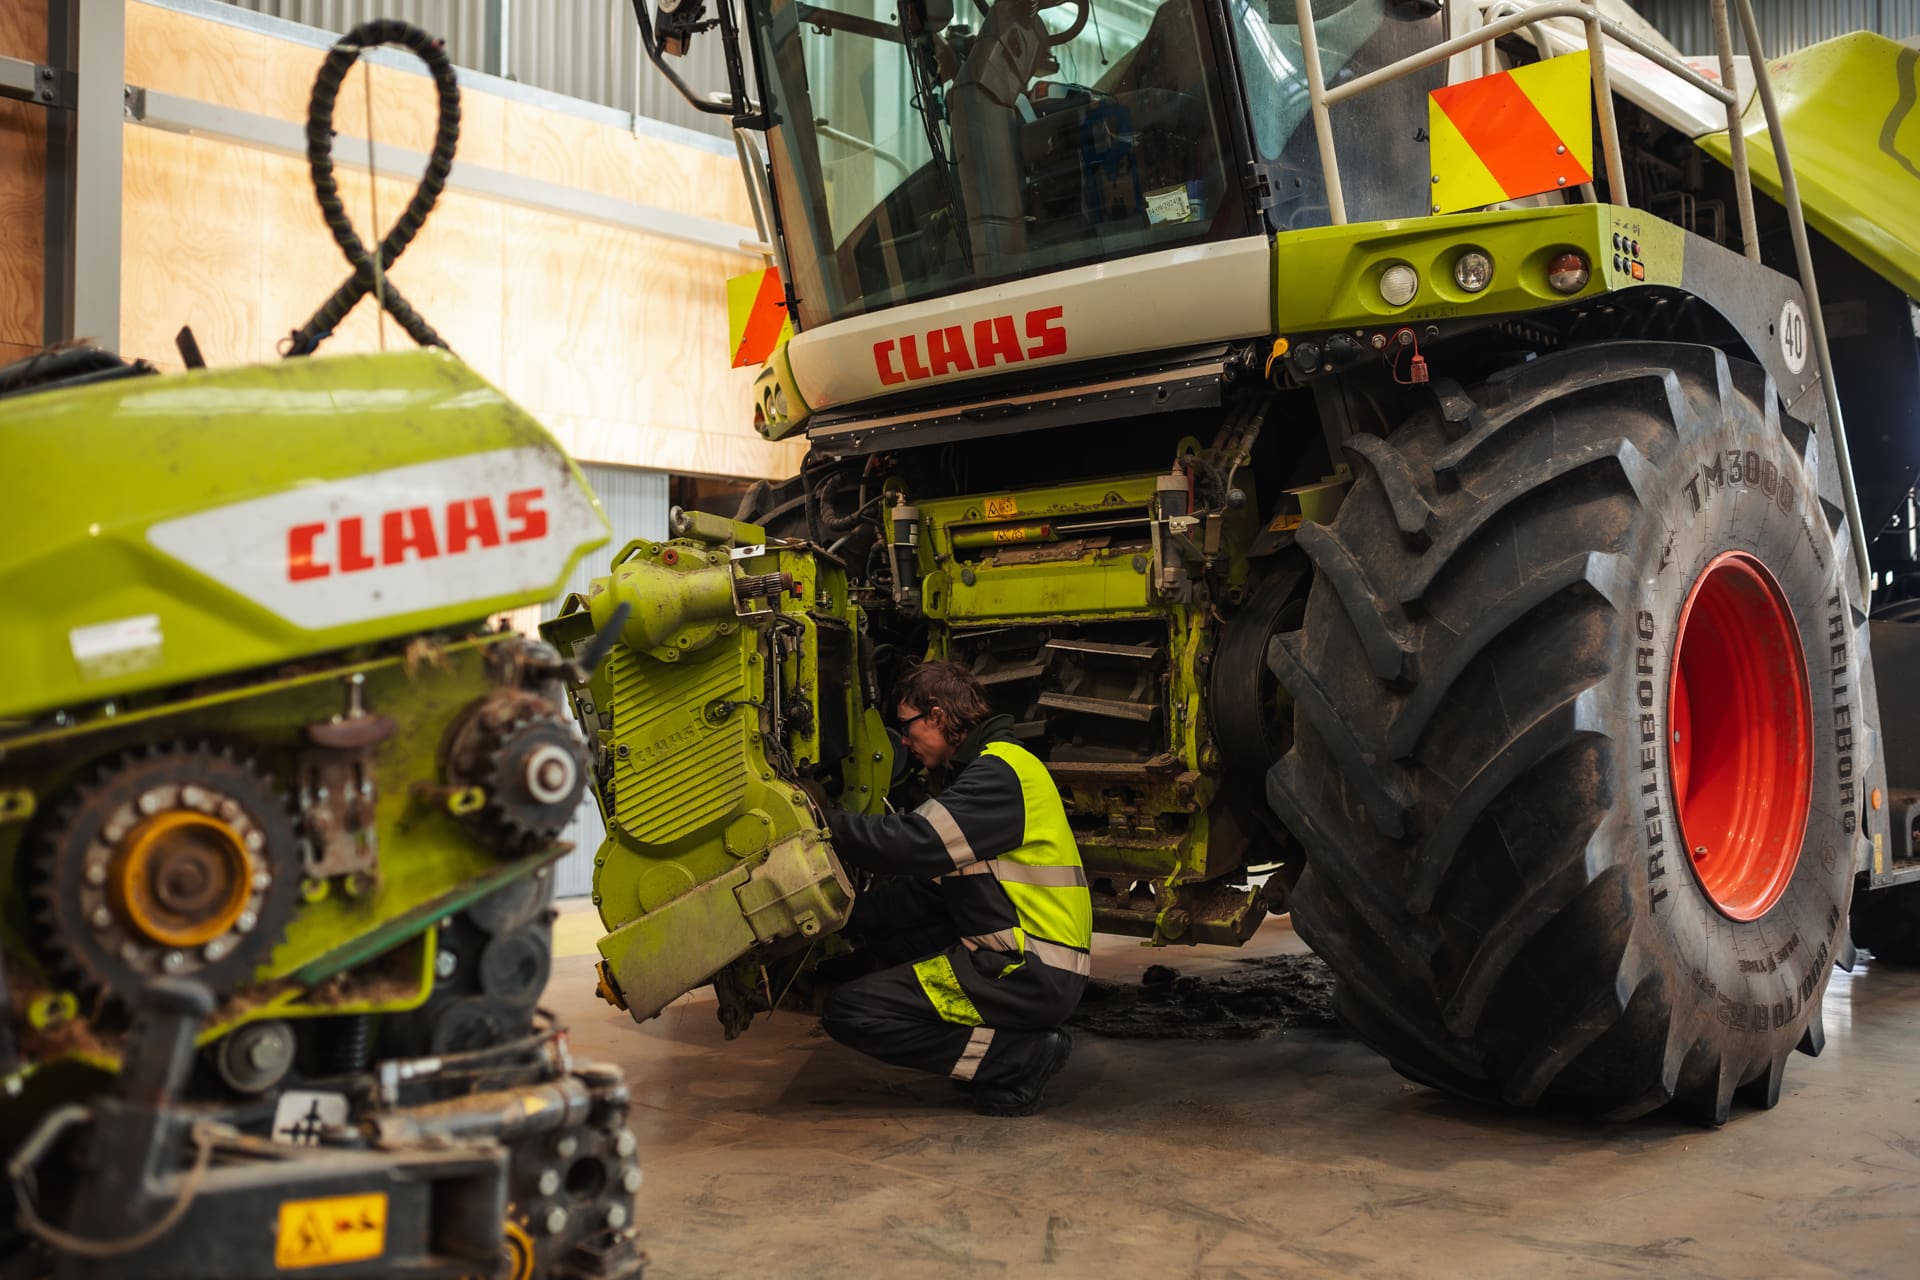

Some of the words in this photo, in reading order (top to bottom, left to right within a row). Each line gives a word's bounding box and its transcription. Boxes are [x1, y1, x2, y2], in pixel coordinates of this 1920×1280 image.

[873, 306, 1067, 385] CLAAS
[1785, 312, 1803, 360] 40
[1682, 449, 1794, 517] TM3000
[288, 488, 546, 582] CLAAS
[635, 725, 695, 762] CLAAS
[1828, 589, 1856, 834] TRELLEBORG
[1636, 610, 1668, 915] TRELLEBORG
